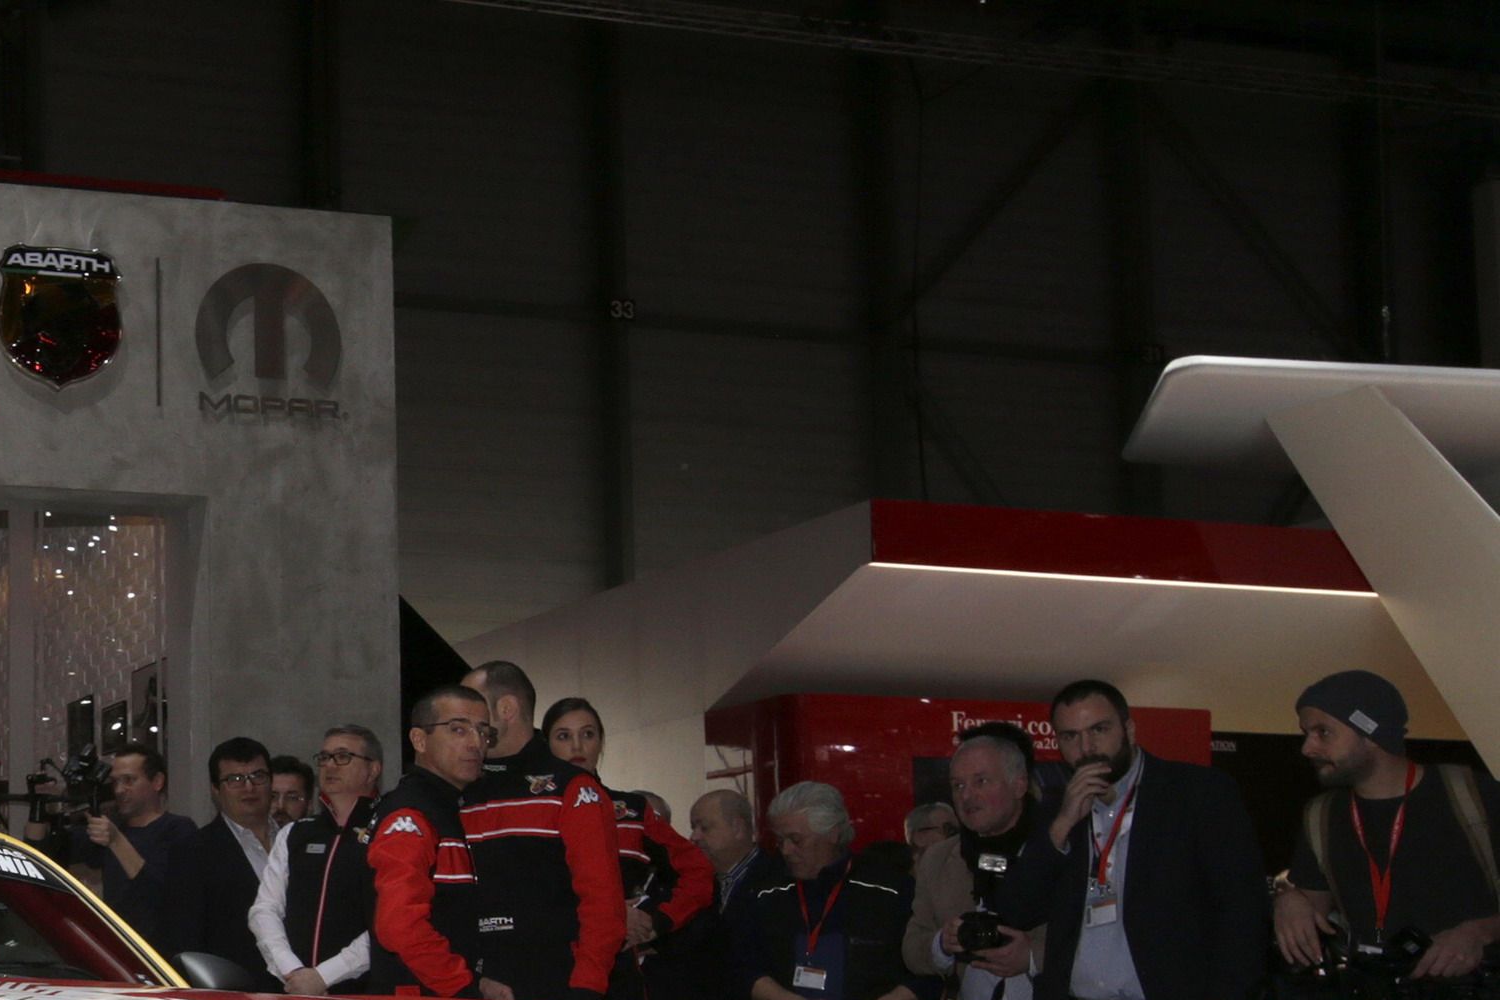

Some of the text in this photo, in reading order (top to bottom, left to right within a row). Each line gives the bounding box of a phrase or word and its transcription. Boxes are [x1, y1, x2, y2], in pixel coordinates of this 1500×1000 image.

[5, 251, 111, 274] ABARTH
[610, 299, 634, 319] 33
[198, 391, 340, 419] MOPAR
